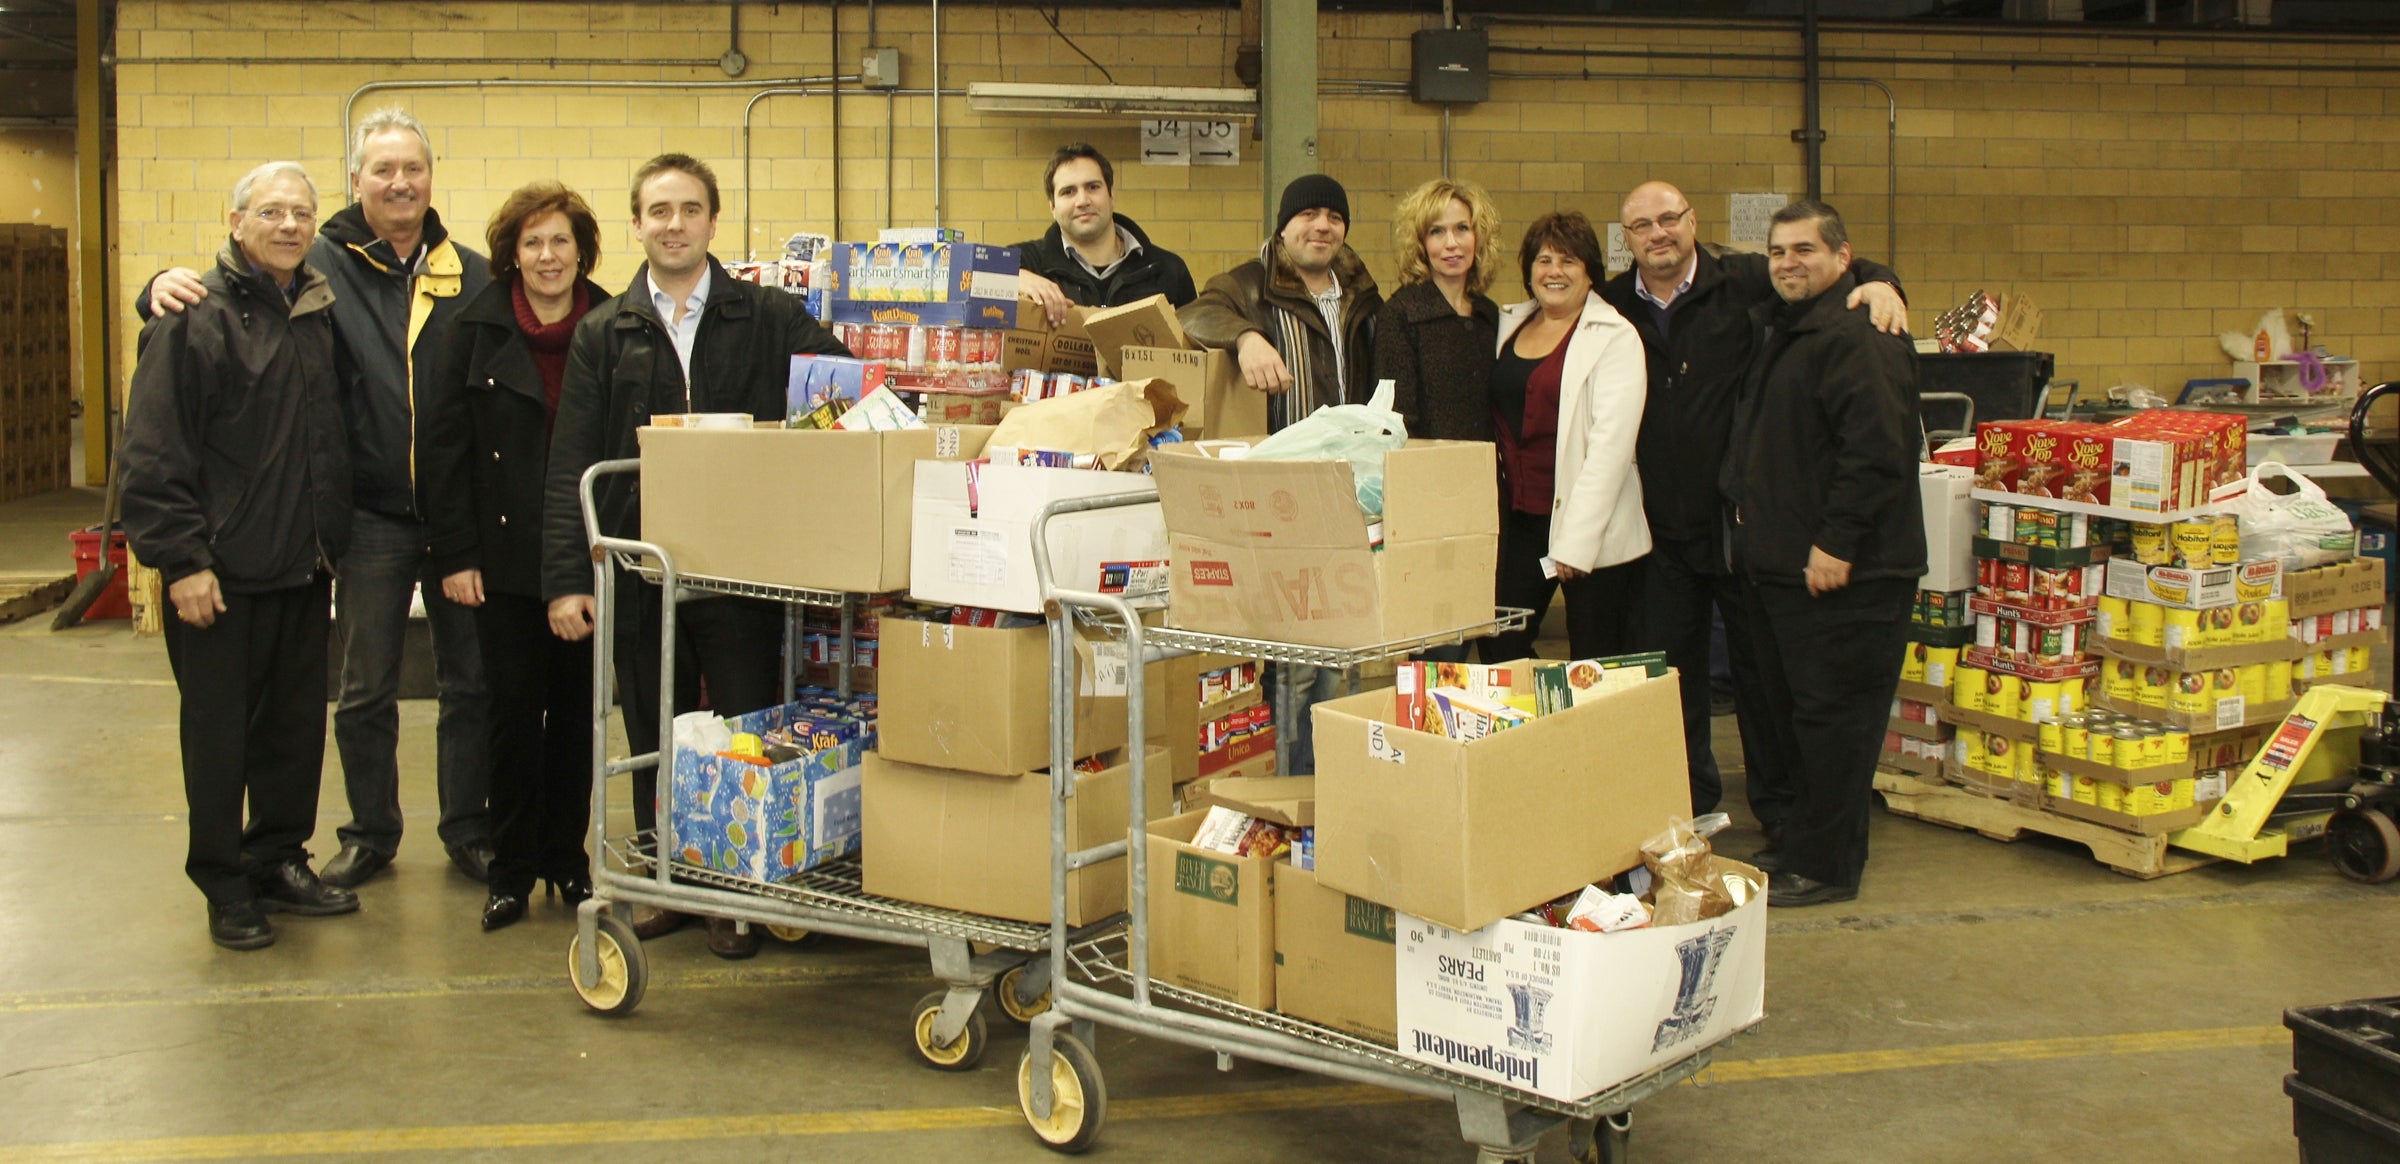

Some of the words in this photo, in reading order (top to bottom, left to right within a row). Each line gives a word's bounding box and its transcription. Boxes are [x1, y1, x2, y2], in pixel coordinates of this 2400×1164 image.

[1148, 120, 1180, 137] J4
[1198, 120, 1231, 138] J5
[873, 246, 891, 258] Kraft
[905, 246, 923, 258] Kraft
[867, 266, 898, 279] smart
[900, 267, 930, 279] smart
[784, 285, 808, 297] QUAKER
[871, 307, 895, 323] Kraft
[894, 307, 920, 325] Dinner
[1124, 351, 1131, 361] 6
[1137, 352, 1149, 362] 1.5
[1172, 352, 1188, 365] 14.1
[1189, 353, 1200, 367] kg
[1979, 428, 2013, 452] Stove
[2022, 433, 2058, 457] Stove
[1990, 444, 2008, 458] Top
[2034, 449, 2052, 463] Top
[2067, 437, 2105, 463] Stove
[2081, 454, 2099, 469] Top
[2177, 533, 2210, 543] Habitant
[1193, 566, 1231, 581] STAPLES
[1996, 607, 2021, 619] Hunt's
[1992, 658, 2016, 671] Hunt's
[811, 732, 838, 751] Kraft
[1228, 743, 1250, 761] Unico
[1180, 857, 1206, 879] RIVER
[1179, 872, 1206, 892] RANCH
[1350, 896, 1380, 919] RIVER
[1472, 946, 1502, 964] BARTLETT
[1438, 954, 1484, 983] PEARS
[1551, 964, 1561, 977] US
[1411, 1028, 1539, 1089] Independent
